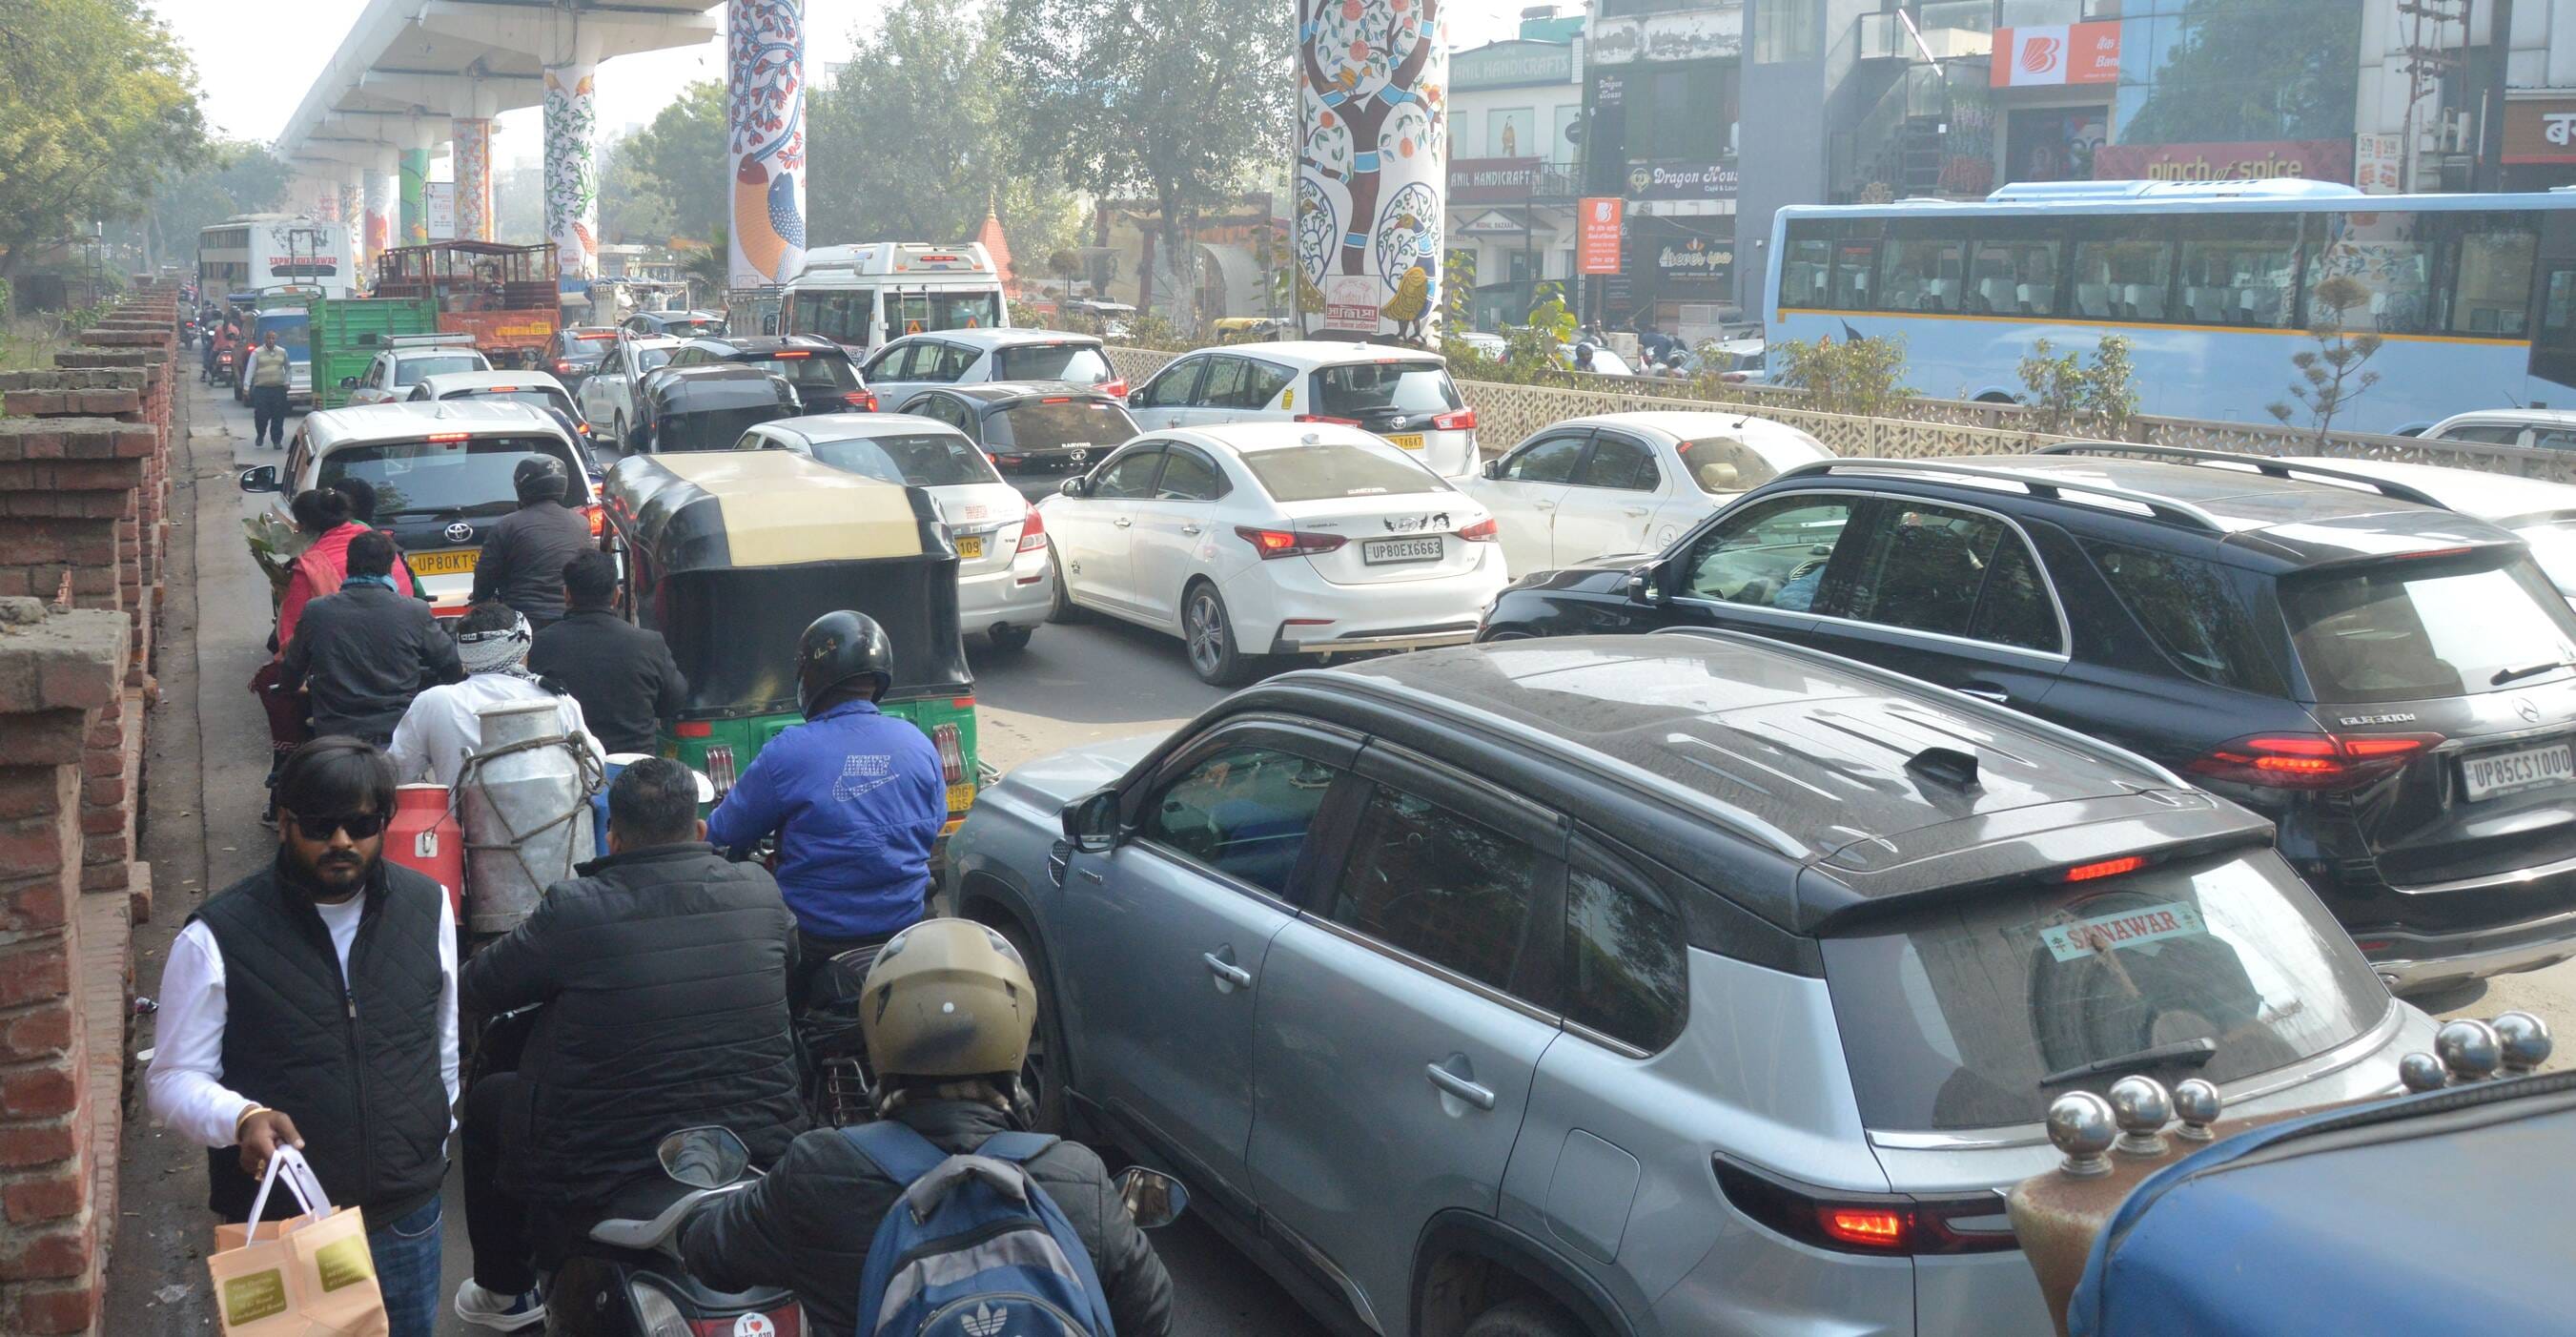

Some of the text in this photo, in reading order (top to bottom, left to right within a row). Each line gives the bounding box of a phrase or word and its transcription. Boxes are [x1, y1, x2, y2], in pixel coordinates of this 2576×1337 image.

[1453, 54, 1568, 82] ANIL HANDICRAFTS
[2149, 152, 2303, 181] pinch of spice
[1450, 169, 1531, 188] ANIL HANDICRAFT
[1653, 167, 1699, 189] Dragon
[956, 540, 980, 554] 109
[1373, 541, 1441, 560] UP80EX6663
[418, 554, 480, 571] UP80KT9
[2473, 749, 2571, 788] UP85CS1000
[2067, 911, 2183, 951] SANAWAR
